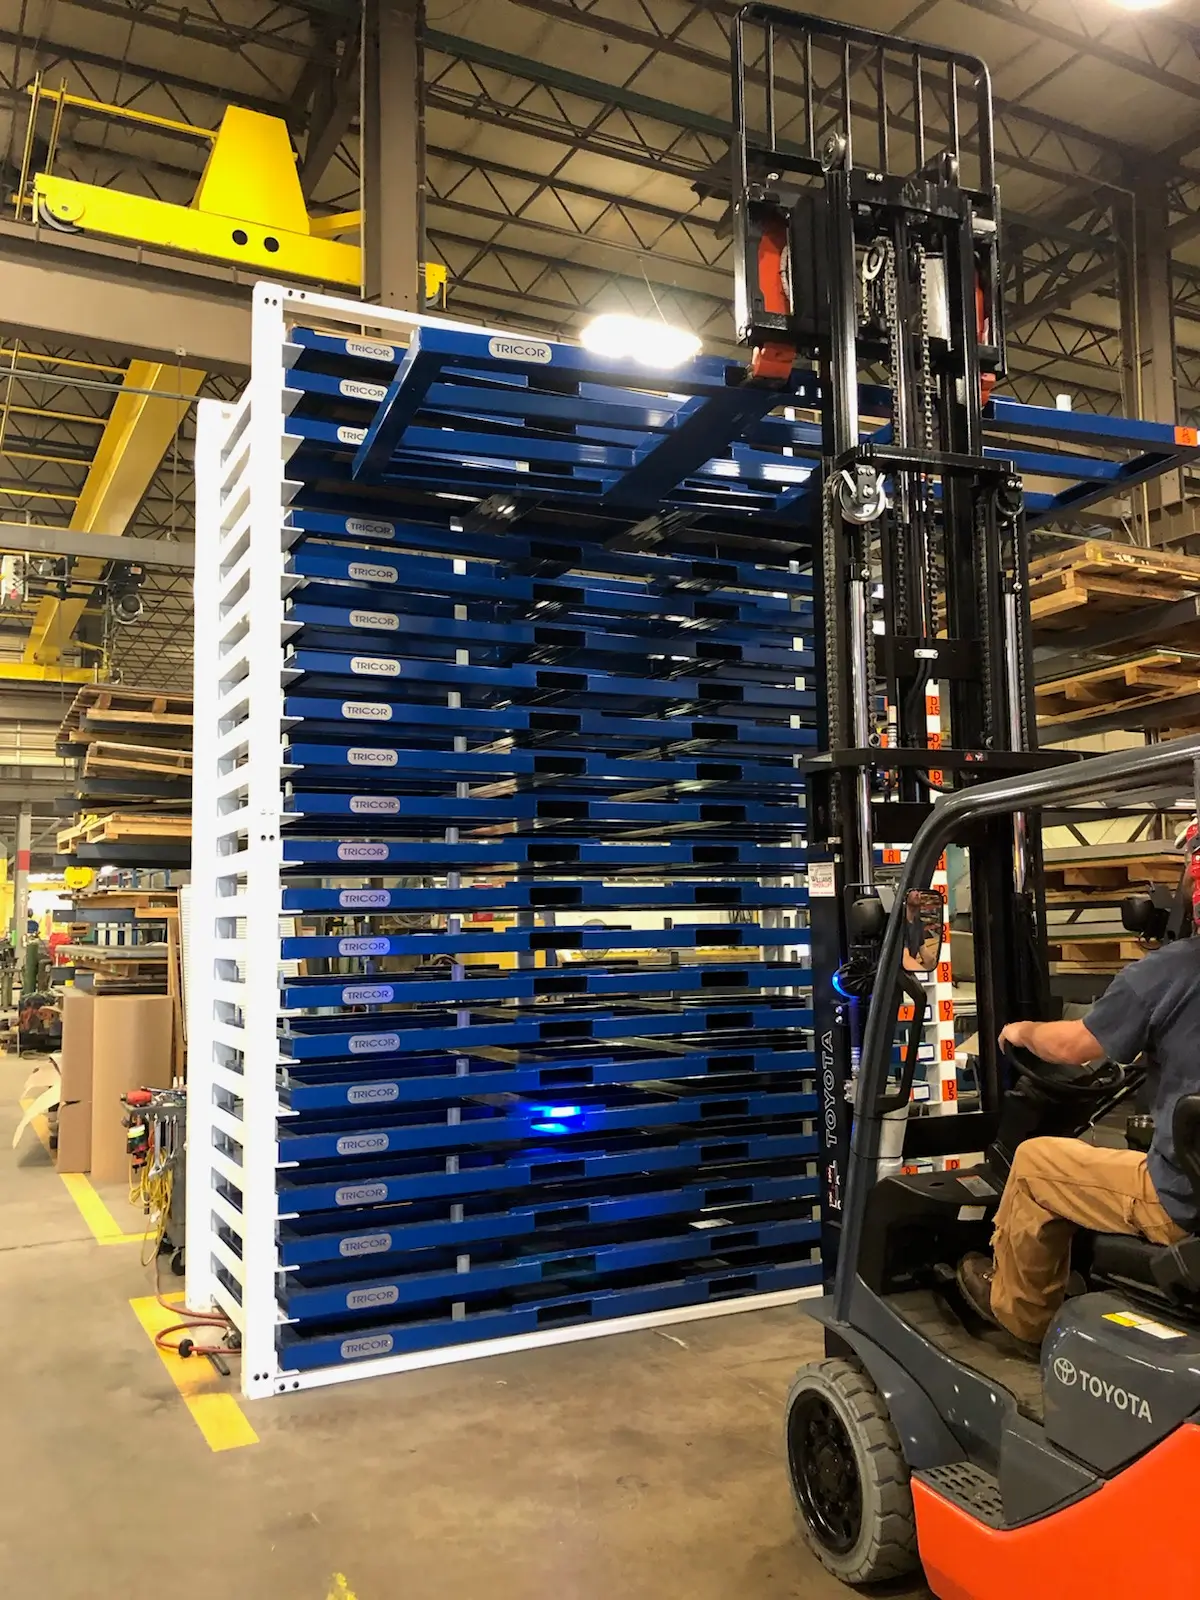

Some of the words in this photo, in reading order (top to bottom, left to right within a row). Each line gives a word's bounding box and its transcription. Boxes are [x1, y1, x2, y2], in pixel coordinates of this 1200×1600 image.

[350, 343, 390, 358] TRICOR
[495, 343, 546, 358] TRICOR
[344, 384, 385, 398] TRICOR
[342, 431, 364, 441] TRIC
[351, 521, 392, 535] TRICOR
[353, 567, 394, 579] TRICOR
[354, 615, 395, 626] TRICOR
[355, 661, 397, 673] TRICOR
[931, 697, 938, 706] D
[346, 706, 388, 717] TRICOR
[929, 706, 940, 716] 15
[352, 752, 394, 763] TRICOR
[934, 771, 941, 781] D
[354, 799, 397, 810] TRICOR
[343, 846, 385, 857] TRICOR
[344, 894, 387, 905] TRICOR
[344, 941, 386, 953] TRICOR
[941, 962, 949, 972] D
[943, 972, 949, 982] 8
[347, 989, 391, 1000] TRICOR
[943, 1000, 951, 1011] D
[945, 1011, 951, 1020] 7
[354, 1038, 396, 1049] TRICOR
[945, 1040, 953, 1050] D
[946, 1050, 953, 1060] 6
[821, 1030, 838, 1148] TOYOTA
[947, 1080, 955, 1089] D
[353, 1087, 395, 1099] TRICOR
[948, 1089, 954, 1100] 5
[342, 1137, 385, 1150] TRICOR
[341, 1187, 383, 1200] TRICOR
[344, 1237, 387, 1252] TRICOR
[352, 1290, 394, 1304] TRICOR
[346, 1339, 389, 1353] TRICOR
[1079, 1369, 1153, 1424] TOYOTA
